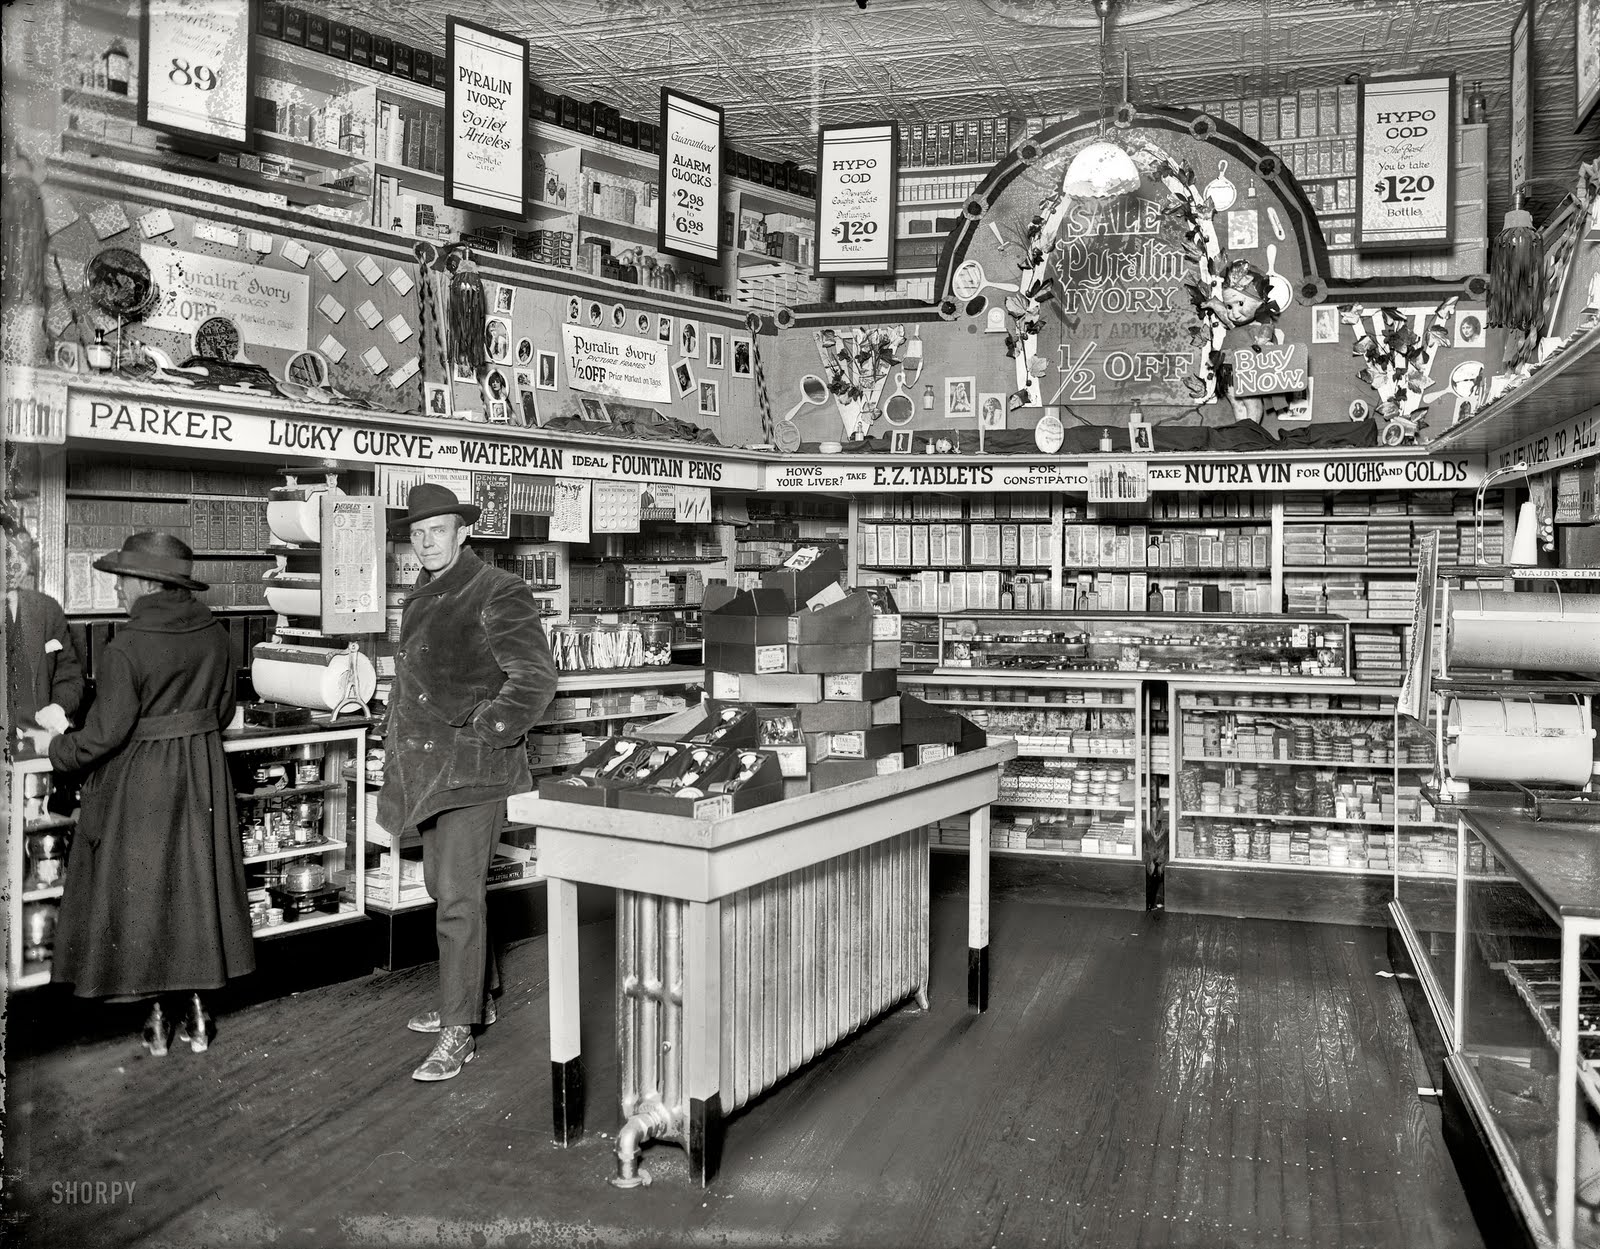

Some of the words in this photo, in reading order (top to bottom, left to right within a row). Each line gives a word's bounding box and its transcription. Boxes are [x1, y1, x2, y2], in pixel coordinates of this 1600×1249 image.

[459, 65, 512, 95] PYRALIN
[467, 89, 507, 110] IVORY
[462, 109, 508, 133] Toilet
[1377, 110, 1436, 124] HYPO
[459, 126, 511, 150] Articles
[671, 131, 716, 153] Guaranteed
[1386, 127, 1428, 139] COD
[467, 152, 501, 166] Complete
[673, 154, 711, 174] ALARM
[833, 159, 877, 170] HYPO
[1398, 162, 1405, 170] to
[1409, 160, 1430, 169] take
[672, 168, 712, 187] CLOCKS
[840, 173, 871, 183] COD
[1067, 198, 1161, 238] SALE
[1055, 236, 1188, 291] Pyralin
[229, 294, 271, 308] BOXES
[247, 278, 291, 304] Ivory
[1065, 286, 1179, 314] IVORY
[573, 335, 620, 357] Pyralin
[625, 345, 657, 366] Ivory
[1234, 344, 1294, 372] Buy
[587, 354, 618, 366] PICTURE
[620, 360, 647, 370] FRAMES
[1103, 351, 1194, 381] OFF
[608, 371, 622, 382] Price
[90, 401, 233, 442] PARKER
[1554, 428, 1567, 459] TO
[1572, 418, 1597, 453] ALL
[268, 419, 343, 450] LUCKY
[353, 430, 434, 460] CURVE
[438, 445, 459, 455] AND
[460, 440, 563, 470] WATERMAN
[572, 455, 608, 468] IDEAL
[612, 454, 684, 478] FOUNTAIN
[688, 461, 723, 481] PENS
[786, 467, 823, 477] HOW'S
[846, 472, 868, 481] TAKE
[1028, 465, 1056, 475] FOR
[1149, 469, 1181, 480] TAKE
[1184, 464, 1252, 484] NUTRA
[1256, 463, 1291, 483] VIN
[1297, 468, 1320, 478] FOR
[1323, 463, 1382, 483] COUGHS
[1380, 467, 1403, 477] AND
[1405, 460, 1468, 482] COLDS
[776, 477, 803, 488] YOUR
[807, 477, 844, 488] LIVER?
[1003, 475, 1088, 486] CONSTIPATIO
